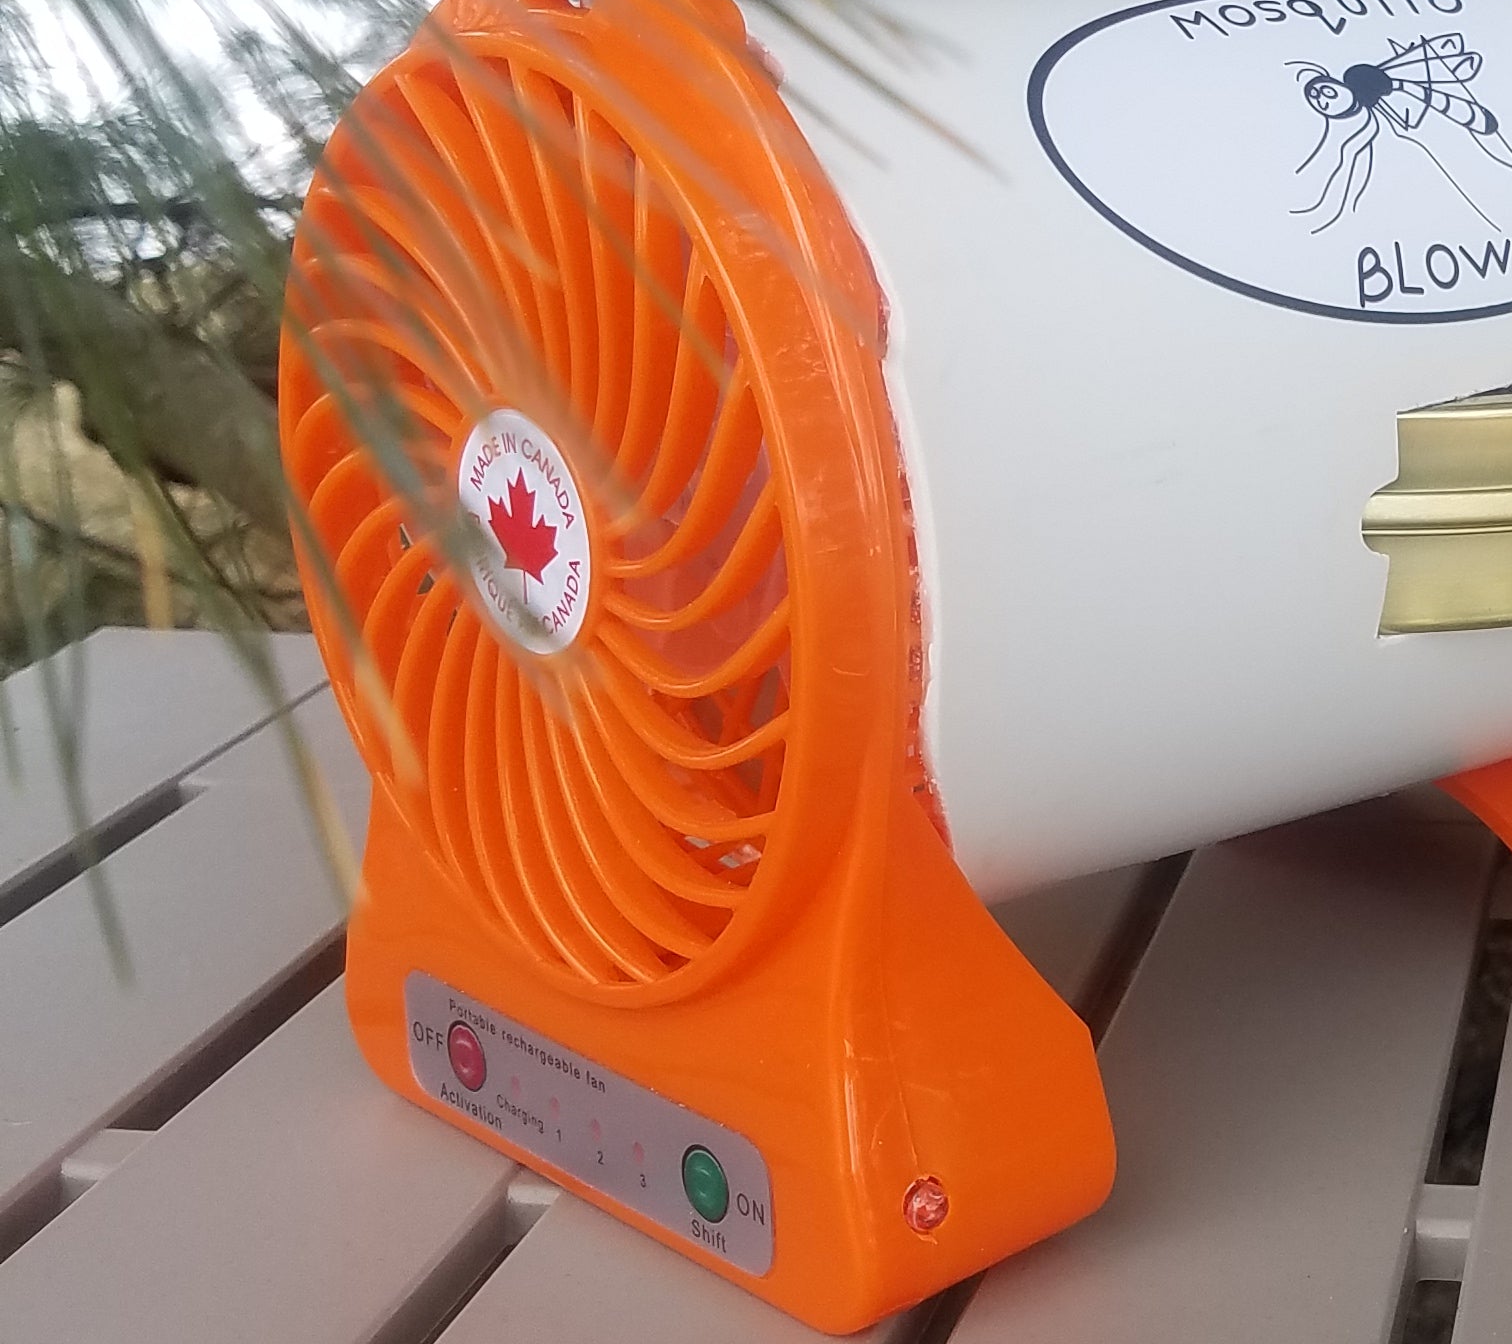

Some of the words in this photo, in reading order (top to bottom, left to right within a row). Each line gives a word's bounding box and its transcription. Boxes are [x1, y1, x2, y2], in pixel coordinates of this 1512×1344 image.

[470, 436, 501, 492] MADE
[502, 432, 517, 454] IN
[521, 439, 575, 529] CANADA
[542, 560, 581, 634] CANADA
[413, 1021, 443, 1051] OFF
[449, 998, 497, 1036] Portable
[501, 1029, 580, 1080] rechargeable
[586, 1071, 606, 1094] fan
[440, 1083, 502, 1131] Activation
[496, 1093, 544, 1134] Charging
[555, 1129, 562, 1142] 1
[597, 1151, 604, 1165] 2
[640, 1174, 647, 1188] 3
[736, 1193, 765, 1226] ON
[691, 1220, 727, 1254] Shift
